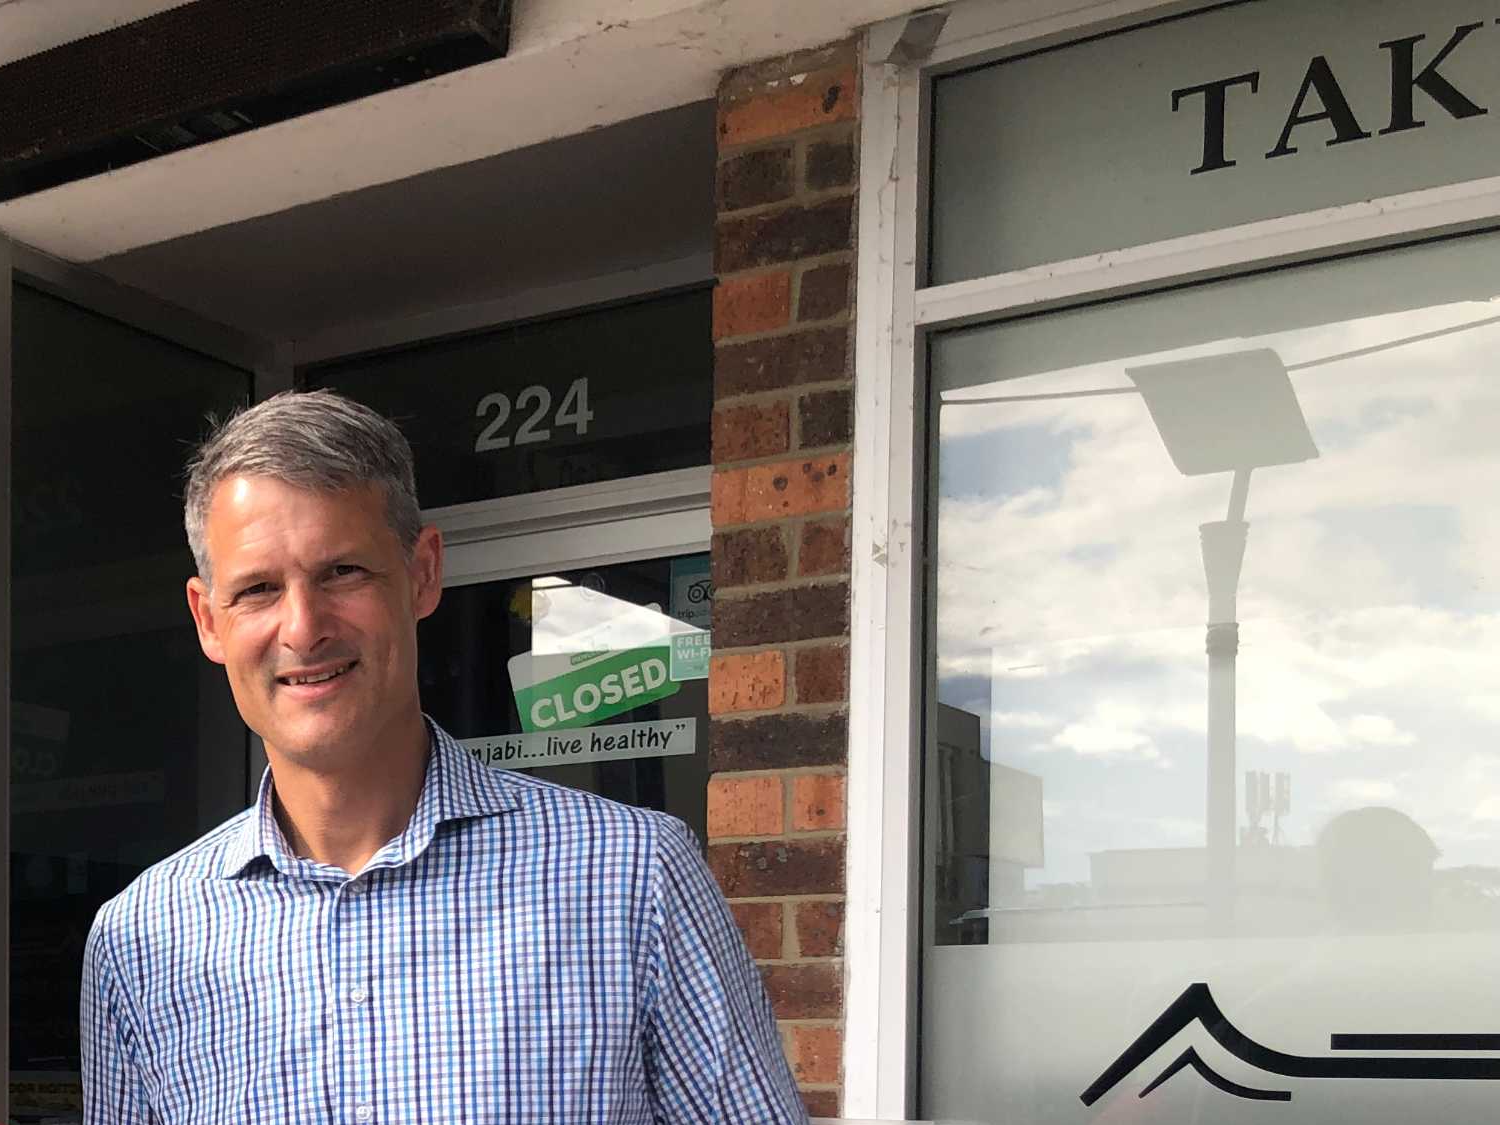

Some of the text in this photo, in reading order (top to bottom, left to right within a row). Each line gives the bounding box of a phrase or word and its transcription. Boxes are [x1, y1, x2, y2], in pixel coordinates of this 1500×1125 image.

[1171, 21, 1489, 175] TAK
[475, 376, 594, 453] 224
[531, 658, 667, 728] CLOSED
